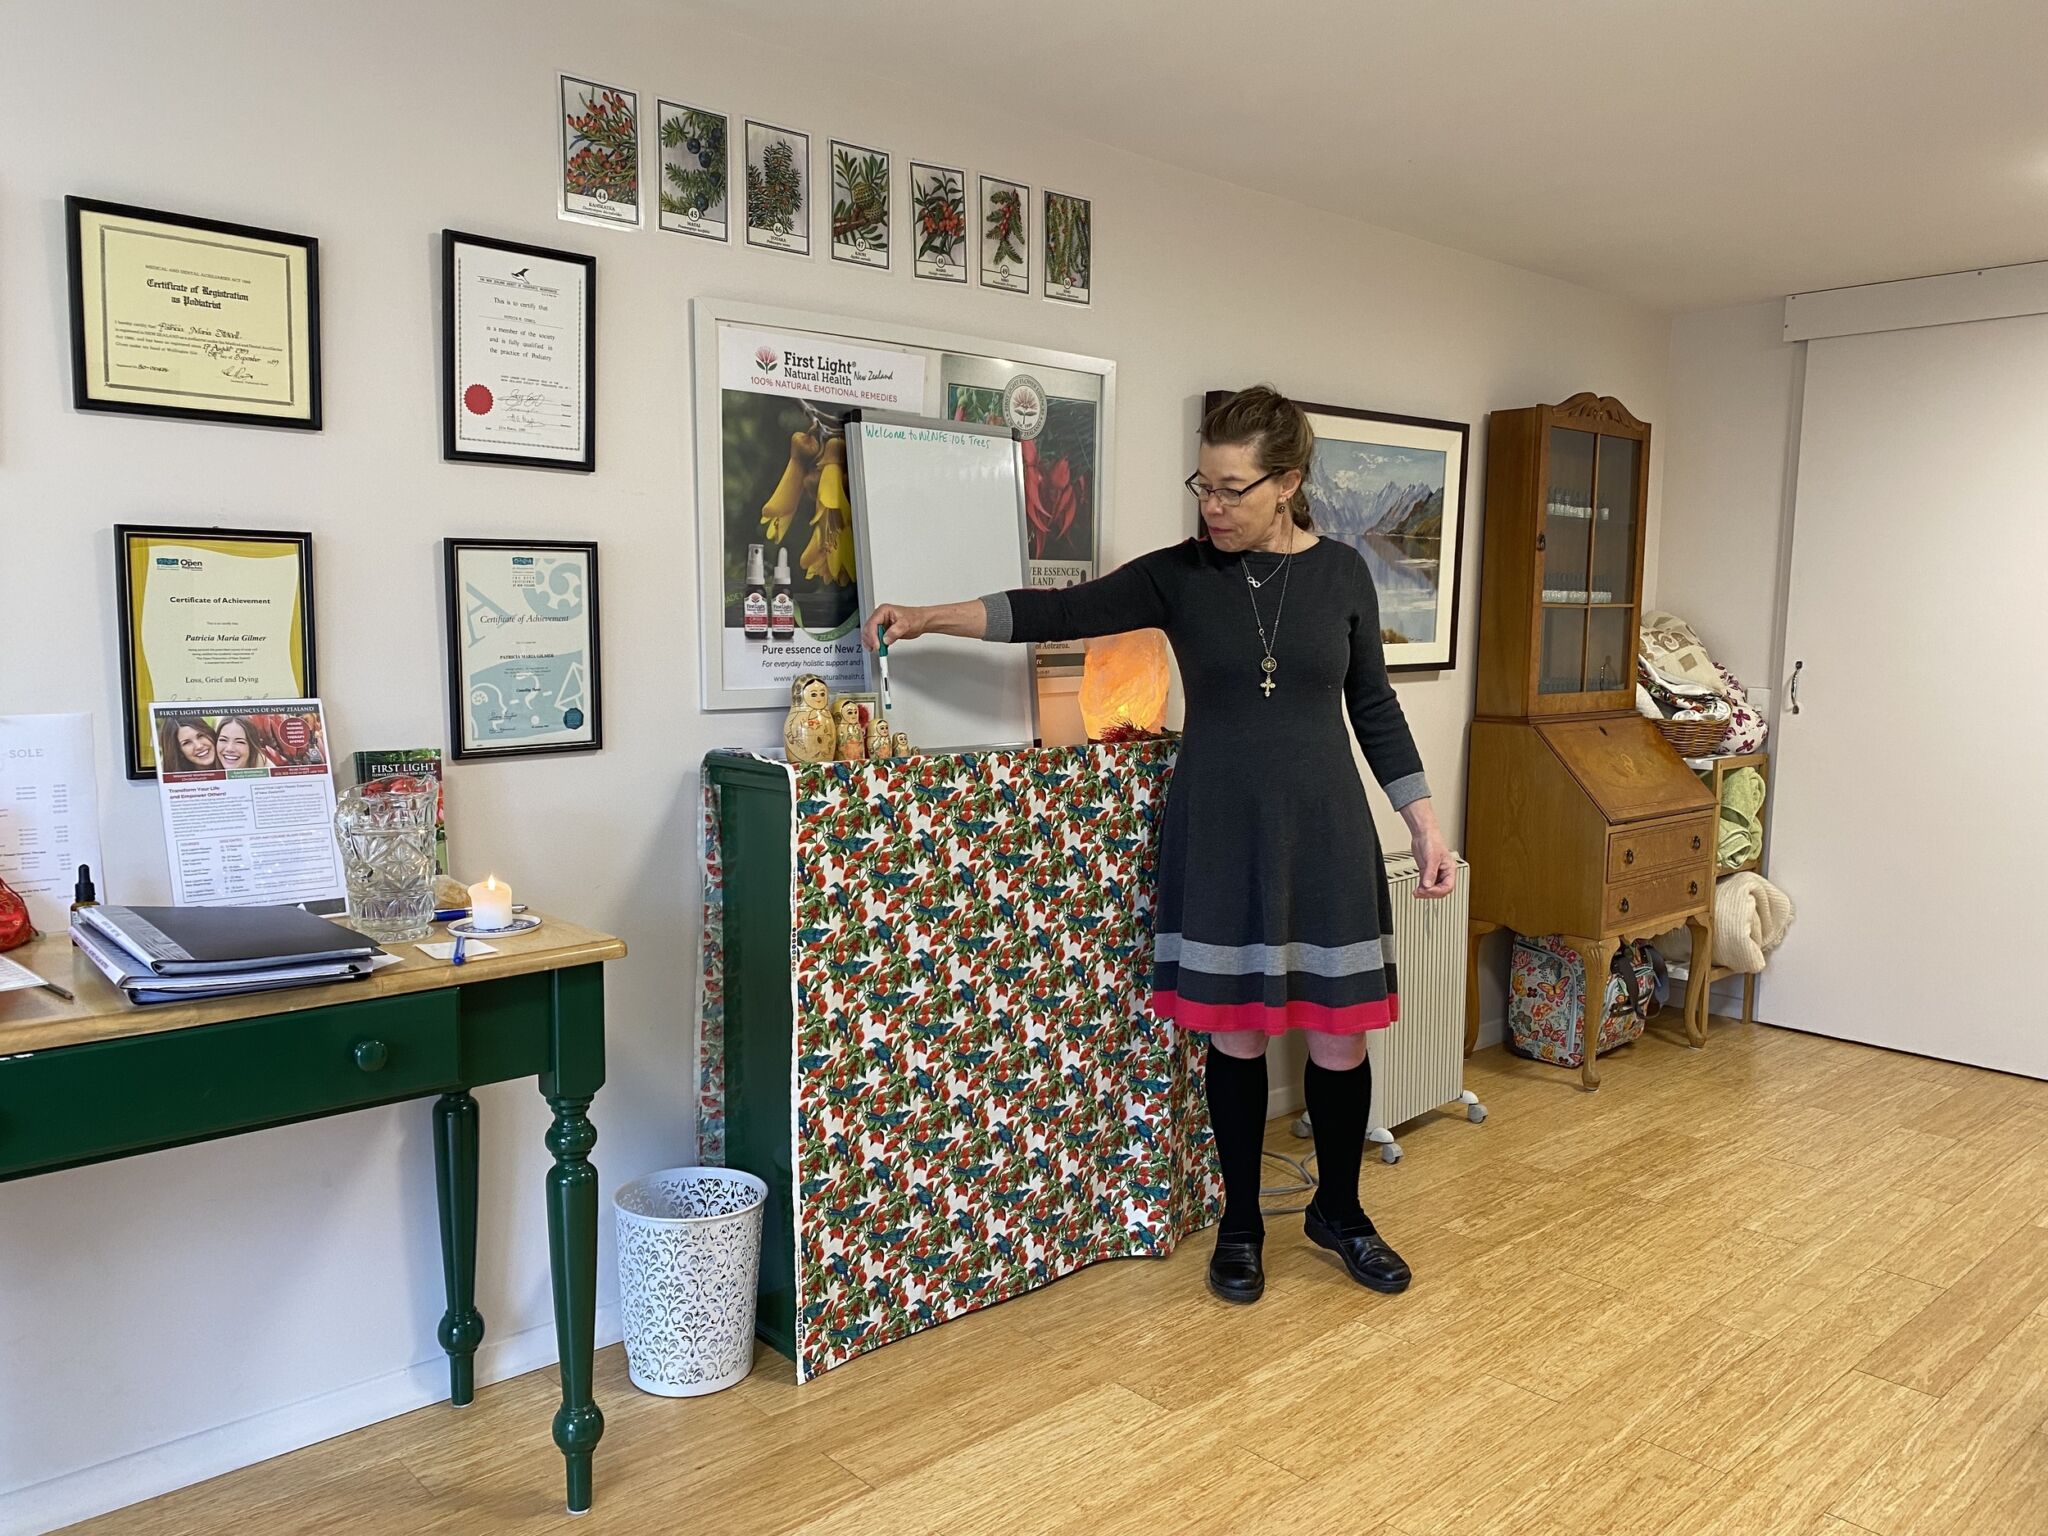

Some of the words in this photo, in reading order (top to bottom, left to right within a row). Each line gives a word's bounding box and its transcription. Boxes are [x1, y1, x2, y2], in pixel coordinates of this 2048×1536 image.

[598, 192, 607, 200] 44
[146, 278, 188, 292] Certificate
[190, 286, 200, 294] of
[202, 286, 248, 301] Registration
[183, 296, 222, 310] Podiatrist
[520, 302, 536, 310] certify
[508, 339, 520, 347] fully
[522, 342, 544, 350] qualified
[784, 351, 814, 369] First
[784, 368, 820, 382] Natural
[822, 372, 852, 386] Health
[854, 372, 866, 381] New
[868, 370, 894, 381] Zealand
[751, 376, 773, 387] 100%
[775, 379, 812, 392] NATURAL
[814, 385, 858, 398] EMOTIONAL
[860, 391, 898, 402] REMEDIES
[865, 424, 906, 440] Welcome
[909, 430, 917, 440] to
[969, 436, 991, 449] Trees
[1031, 567, 1042, 576] ER
[1044, 567, 1080, 577] ESSENCES
[1032, 577, 1054, 586] LAND
[480, 614, 516, 626] Certificate
[517, 614, 525, 625] of
[526, 614, 569, 623] Achievement
[762, 645, 783, 654] Pure
[823, 644, 832, 654] of
[835, 645, 855, 653] New
[856, 644, 862, 653] Z
[825, 660, 849, 668] support
[238, 676, 259, 684] Dying
[9, 748, 44, 758] SOLE
[371, 764, 400, 773] FIRST
[403, 763, 436, 772] LIGHT
